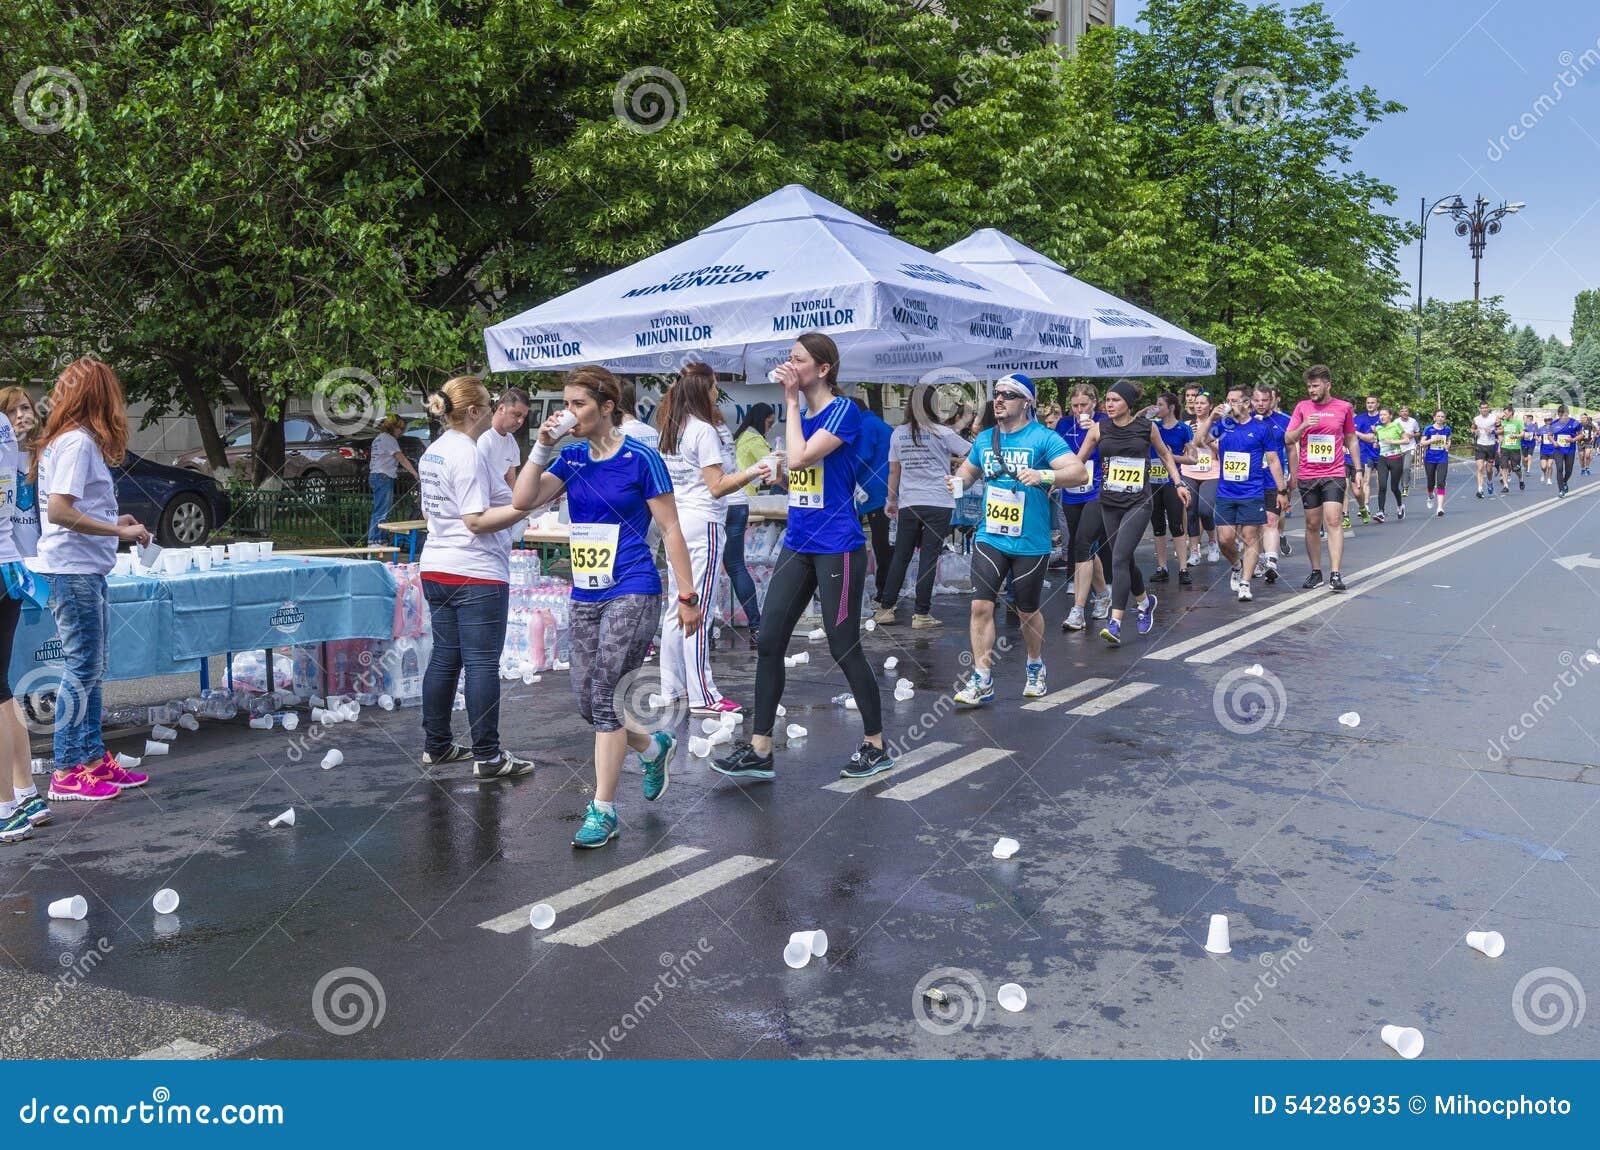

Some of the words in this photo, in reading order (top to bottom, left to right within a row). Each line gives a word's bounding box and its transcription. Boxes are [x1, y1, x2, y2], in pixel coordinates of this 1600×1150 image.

[670, 265, 745, 283] IZVORUL
[619, 270, 770, 299] MINUNILOR
[791, 298, 836, 313] IZVORUL
[902, 297, 928, 314] IZVORUL
[651, 315, 693, 329] IZVORUL
[773, 309, 854, 332] MINUNILOR
[892, 306, 939, 331] MINUNILOR
[522, 332, 563, 345] IZVORUL
[636, 325, 712, 347] MINUNILOR
[970, 322, 1014, 342] MINUNILOR
[504, 341, 581, 362] MINUNILOR
[1310, 444, 1332, 455] 1899
[984, 464, 1029, 478] HPE
[1224, 461, 1247, 471] 5372
[1113, 469, 1140, 483] 1272
[986, 503, 1019, 522] 3648
[573, 548, 611, 568] 3532
